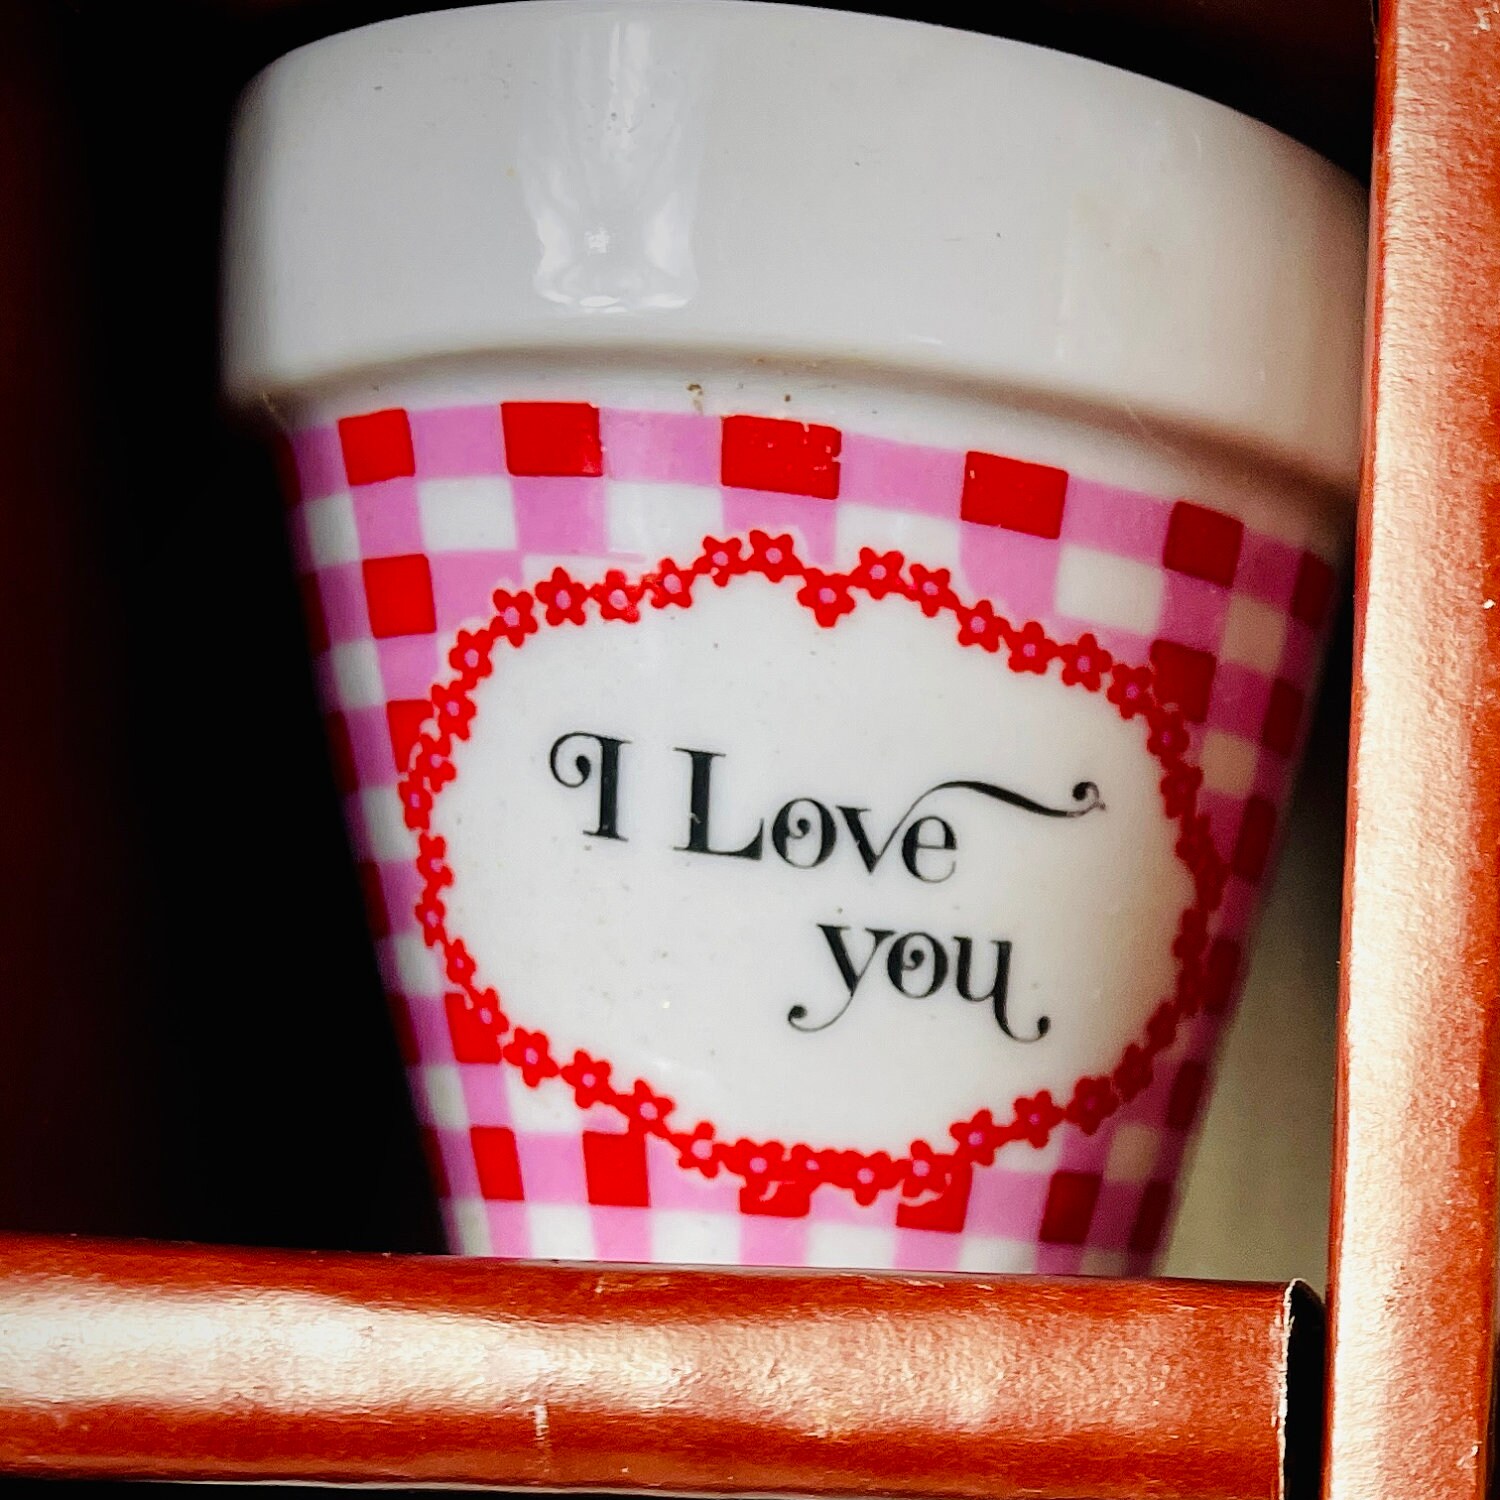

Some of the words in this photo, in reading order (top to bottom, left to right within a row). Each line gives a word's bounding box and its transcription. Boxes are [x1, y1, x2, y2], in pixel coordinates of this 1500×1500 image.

[549, 731, 632, 842] I
[672, 746, 1107, 884] Love
[787, 923, 1051, 1043] you
